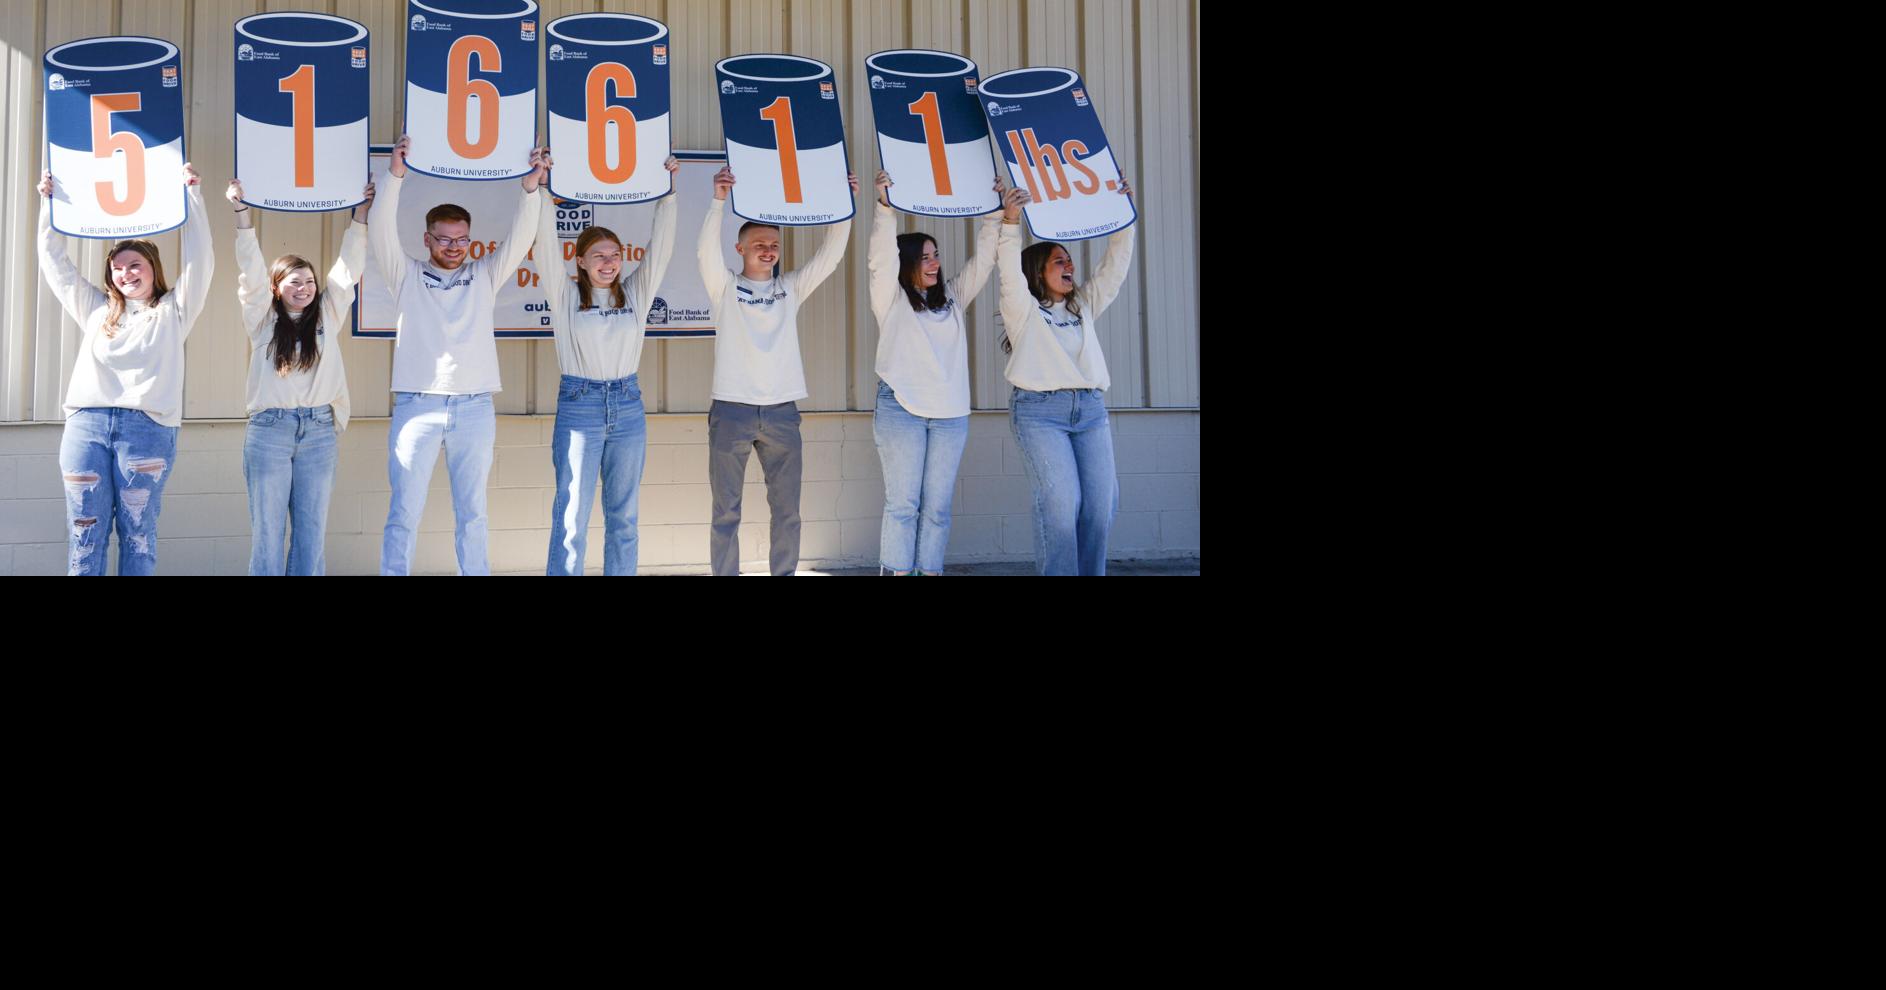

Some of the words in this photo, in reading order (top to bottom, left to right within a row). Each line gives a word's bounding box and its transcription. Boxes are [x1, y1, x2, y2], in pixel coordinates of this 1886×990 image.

[447, 35, 502, 159] 6
[279, 65, 315, 188] 1
[585, 62, 637, 184] 6
[908, 92, 953, 195] 1
[90, 92, 146, 216] 5
[760, 97, 803, 203] 1
[431, 165, 461, 175] AUBURN
[1006, 128, 1117, 203] lbs.
[575, 192, 604, 200] AUBURN
[264, 199, 295, 208] AUBURN
[913, 204, 939, 213] AUBURN
[556, 210, 591, 220] OOD
[760, 213, 788, 221] AUBURN
[80, 226, 111, 234] AUBURN
[556, 221, 591, 231] RIVE
[1056, 229, 1081, 238] AUBURN
